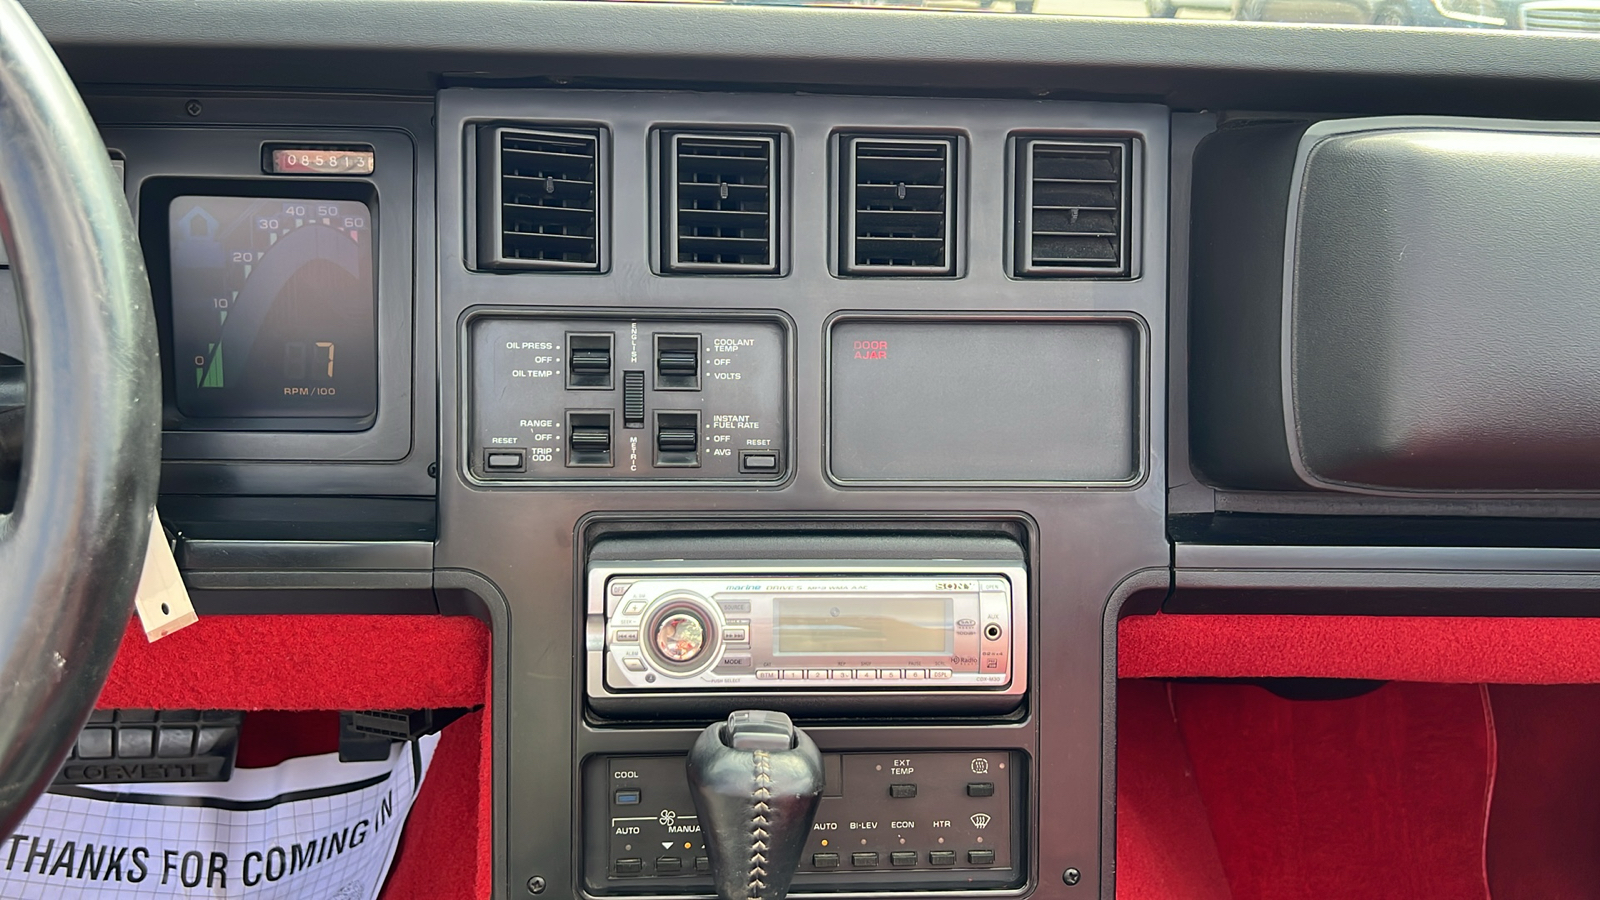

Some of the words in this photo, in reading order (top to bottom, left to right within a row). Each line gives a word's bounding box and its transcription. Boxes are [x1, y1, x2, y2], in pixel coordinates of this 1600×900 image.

[288, 155, 365, 167] 085813
[286, 206, 305, 216] 40
[318, 206, 338, 216] 50
[259, 219, 279, 229] 30
[345, 218, 364, 228] 60
[233, 252, 252, 262] 20
[214, 299, 228, 308] 10
[854, 340, 887, 349] DOOR
[854, 351, 887, 359] AJAR
[195, 356, 204, 366] 0
[64, 763, 210, 780] CORVETTE
[616, 827, 640, 835] AUTO
[668, 825, 701, 833] MANUA
[5, 834, 149, 884] THANKS
[161, 850, 229, 889] FOR
[243, 819, 369, 887] COMING
[374, 789, 394, 834] IN
